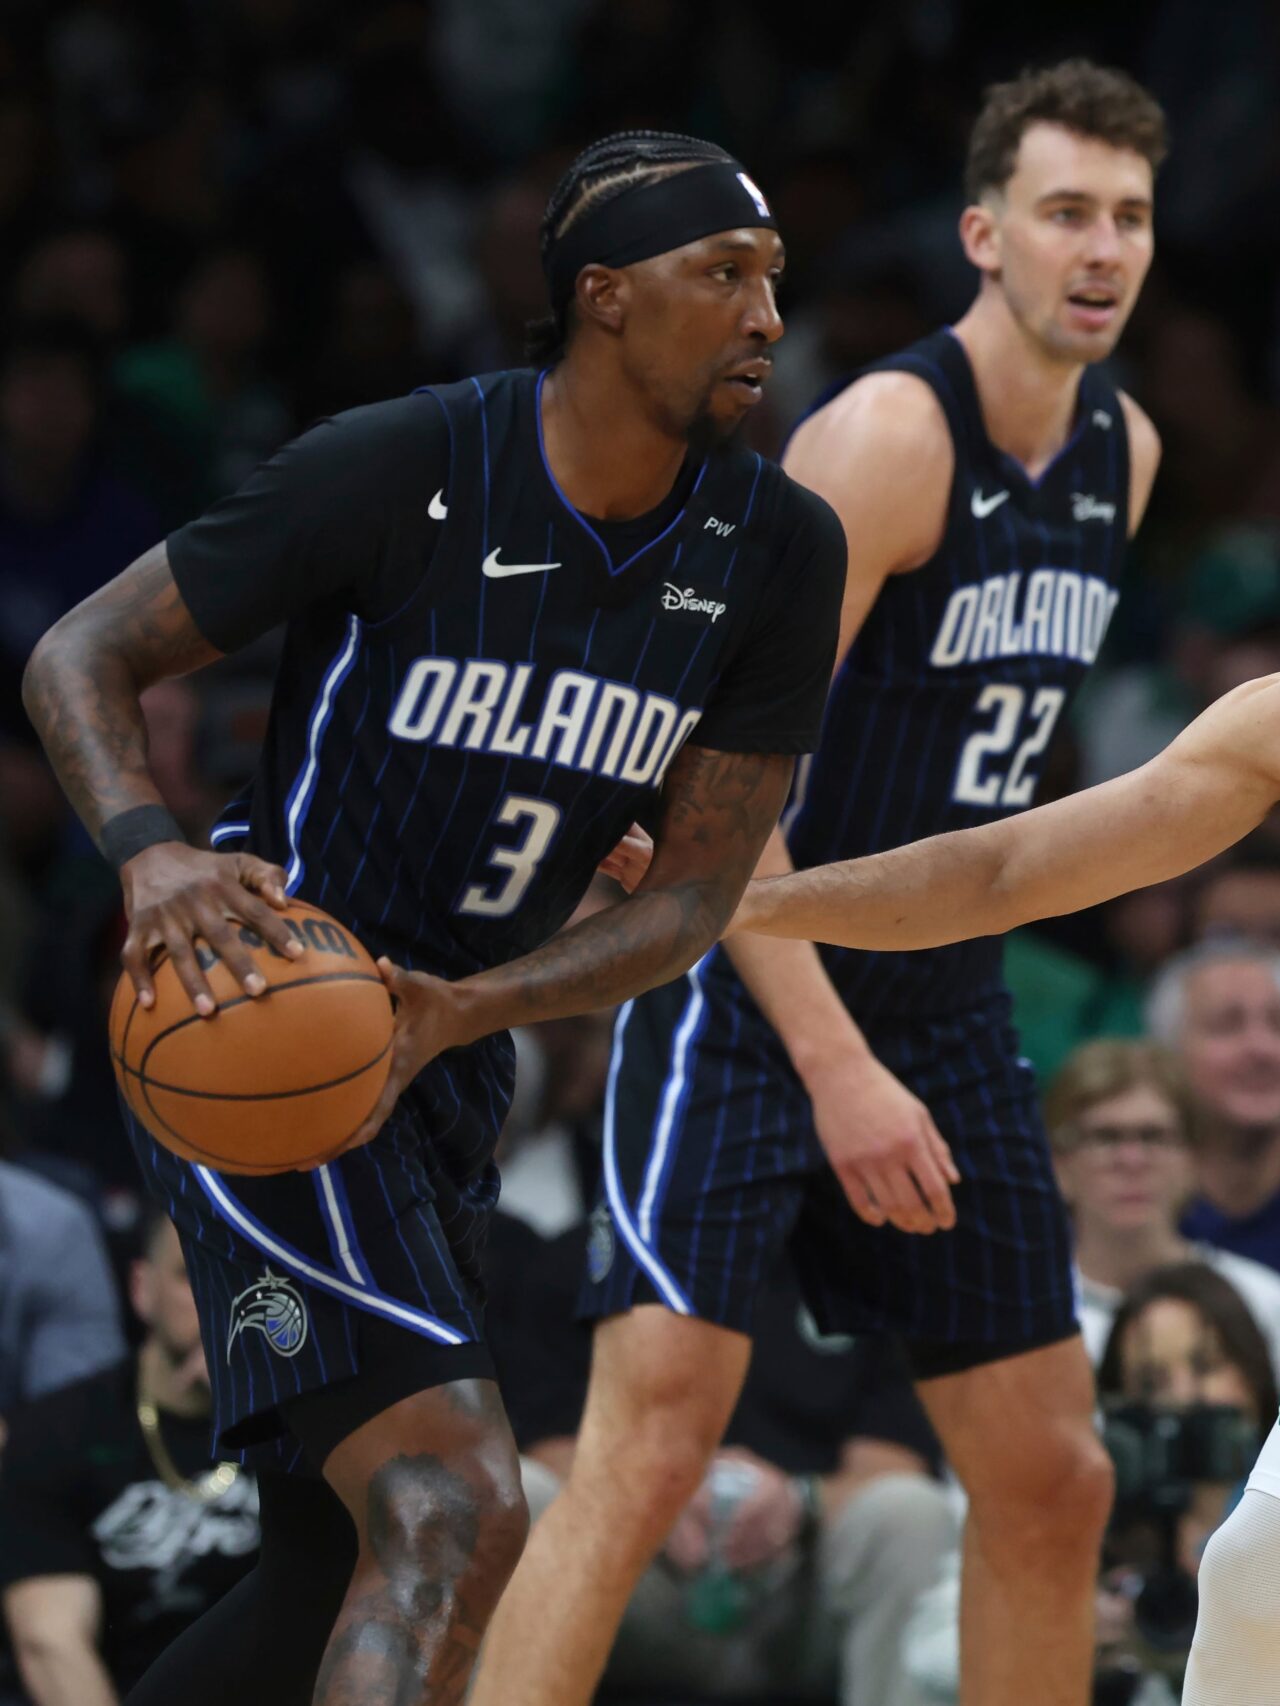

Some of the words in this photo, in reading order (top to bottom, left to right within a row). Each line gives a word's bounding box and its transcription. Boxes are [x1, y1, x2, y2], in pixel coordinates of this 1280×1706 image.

[703, 516, 737, 537] PW
[661, 581, 726, 623] Disney
[953, 682, 1066, 807] 22
[456, 794, 562, 918] 3
